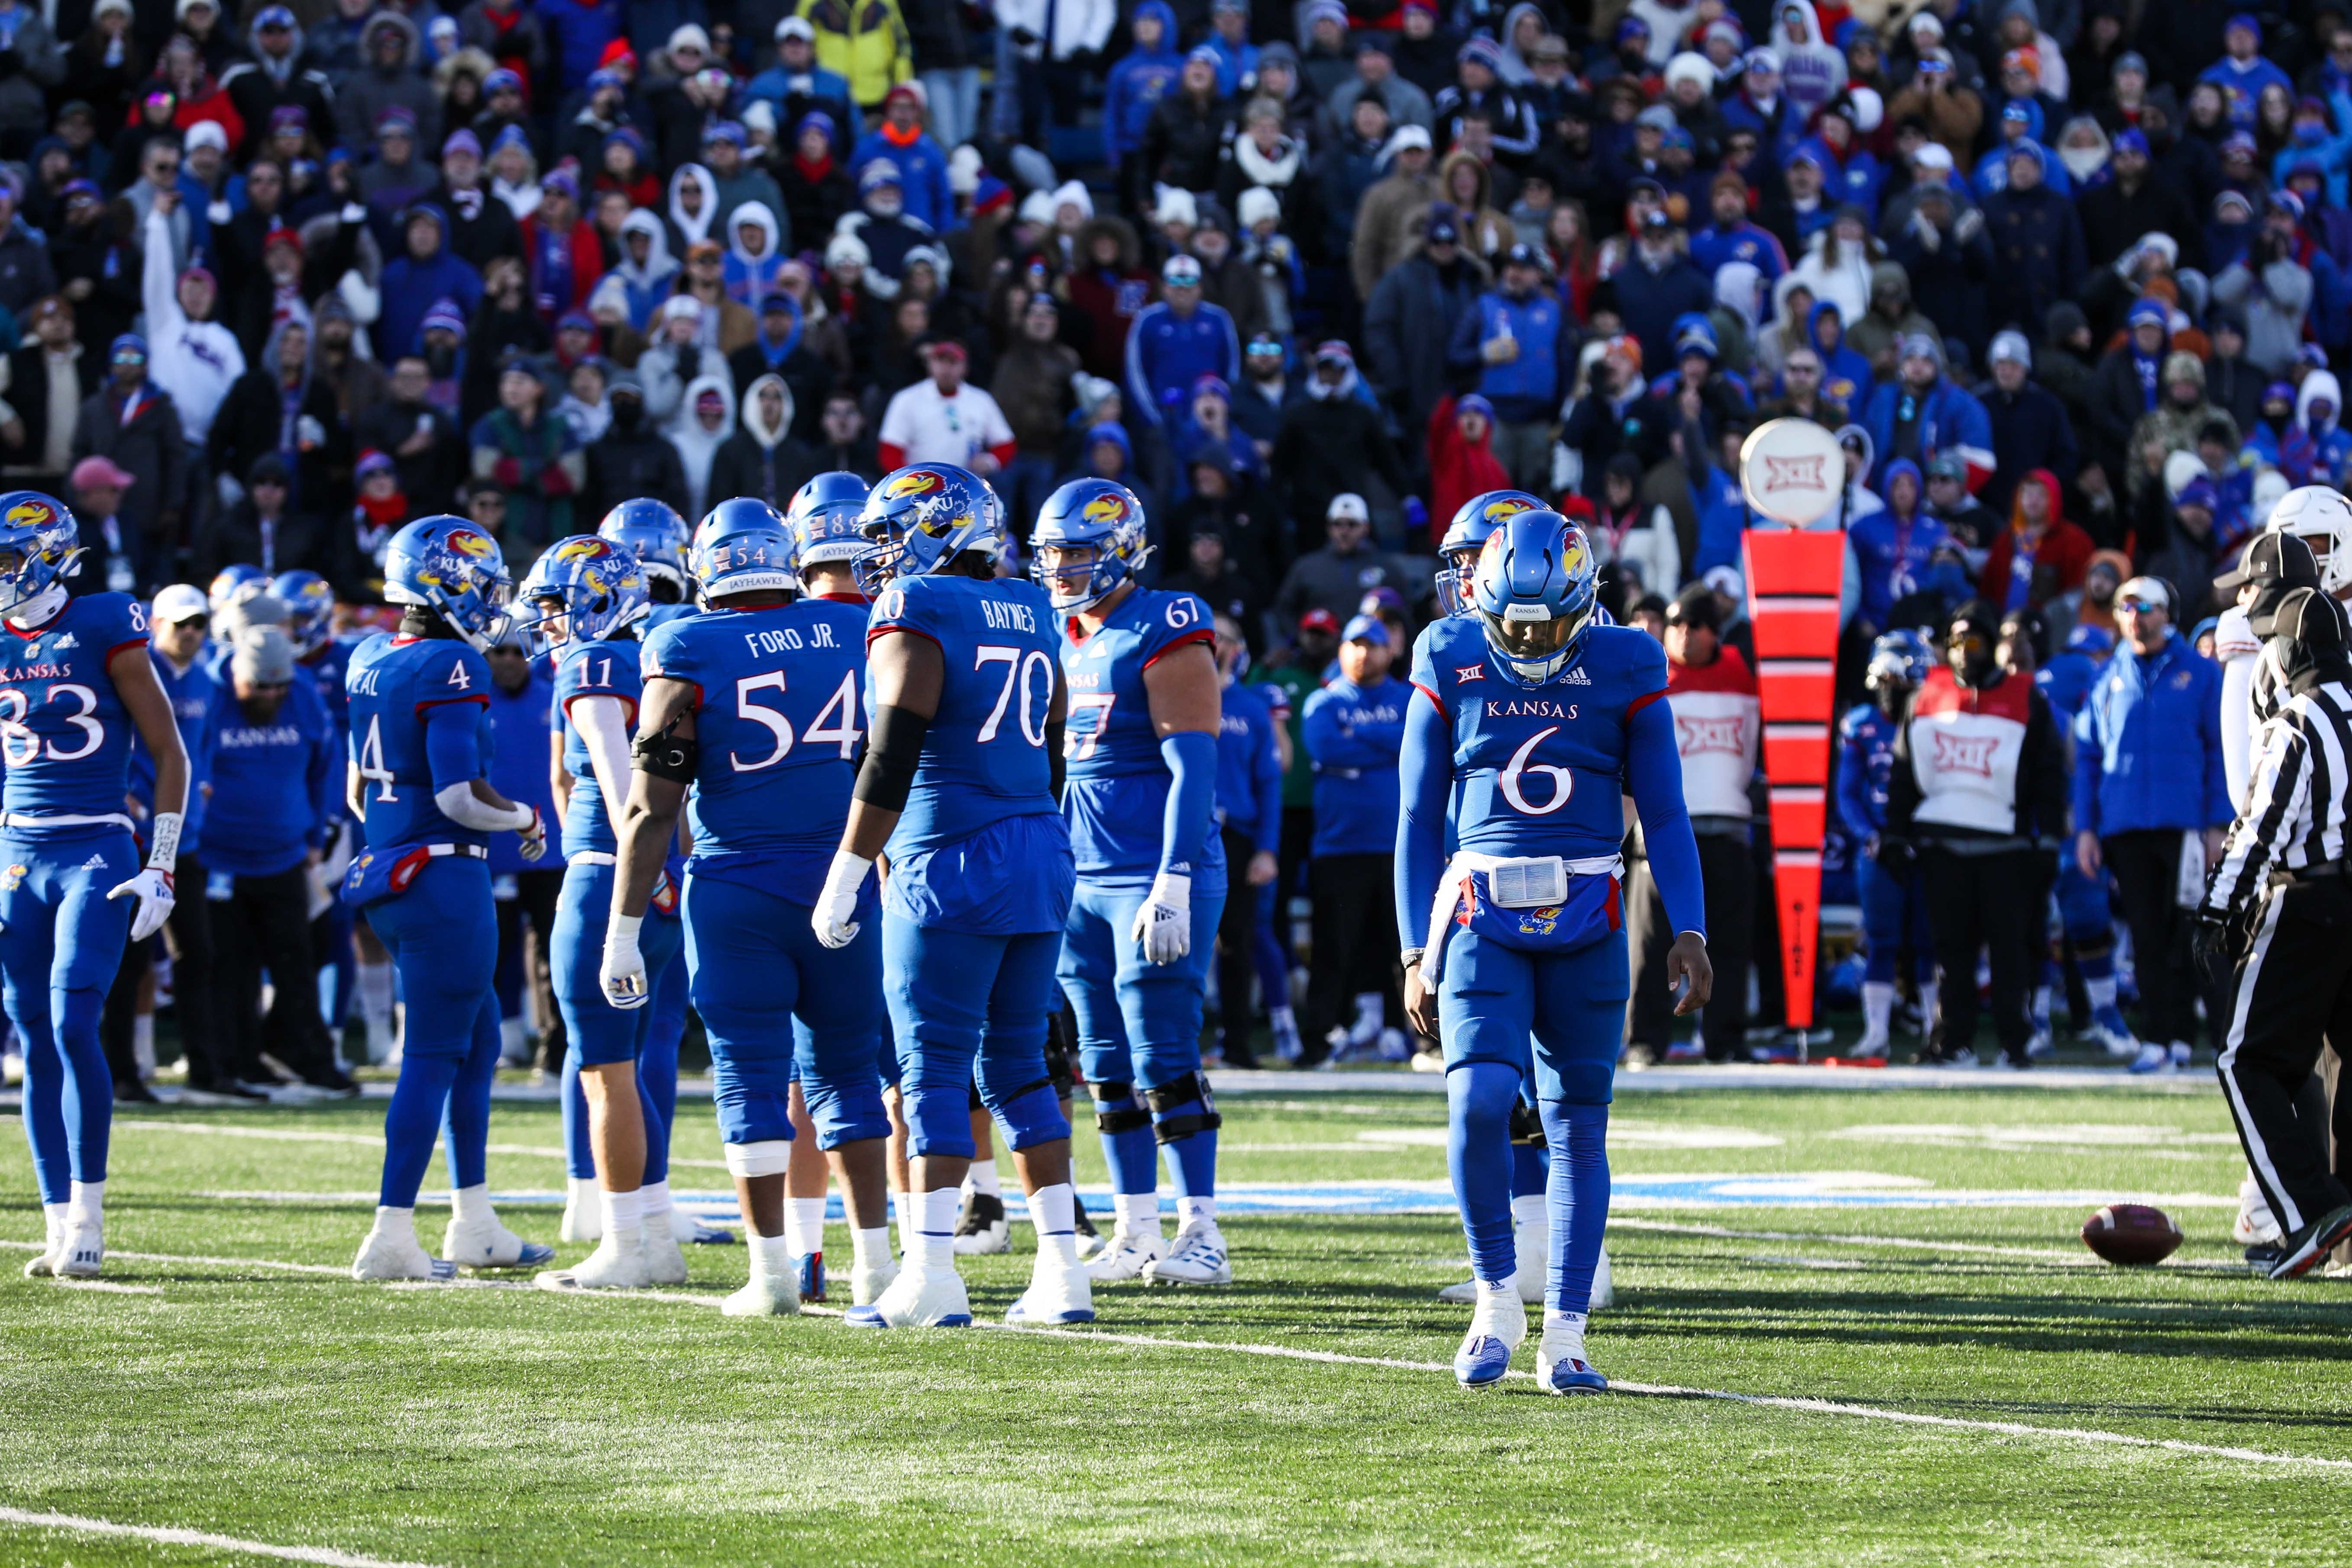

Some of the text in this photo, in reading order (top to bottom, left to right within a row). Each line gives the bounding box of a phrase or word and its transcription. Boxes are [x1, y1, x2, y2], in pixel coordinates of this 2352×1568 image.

[440, 556, 464, 572] KU
[602, 559, 622, 573] KU
[736, 546, 767, 566] 54
[729, 577, 783, 589] JAYHAWKS
[980, 599, 1036, 634] BAYNES
[1165, 597, 1199, 629] 67
[744, 623, 841, 658] FORD JR.
[0, 664, 71, 683] KANSAS
[448, 659, 471, 690] 4
[576, 656, 613, 689] 11
[1454, 663, 1486, 685] XII
[1559, 676, 1592, 686] adidas
[975, 645, 1054, 747] 70
[1487, 701, 1579, 720] KANSAS
[0, 683, 104, 767] 83
[731, 669, 864, 771] 54
[361, 713, 398, 802] 4
[1499, 725, 1575, 816] 6
